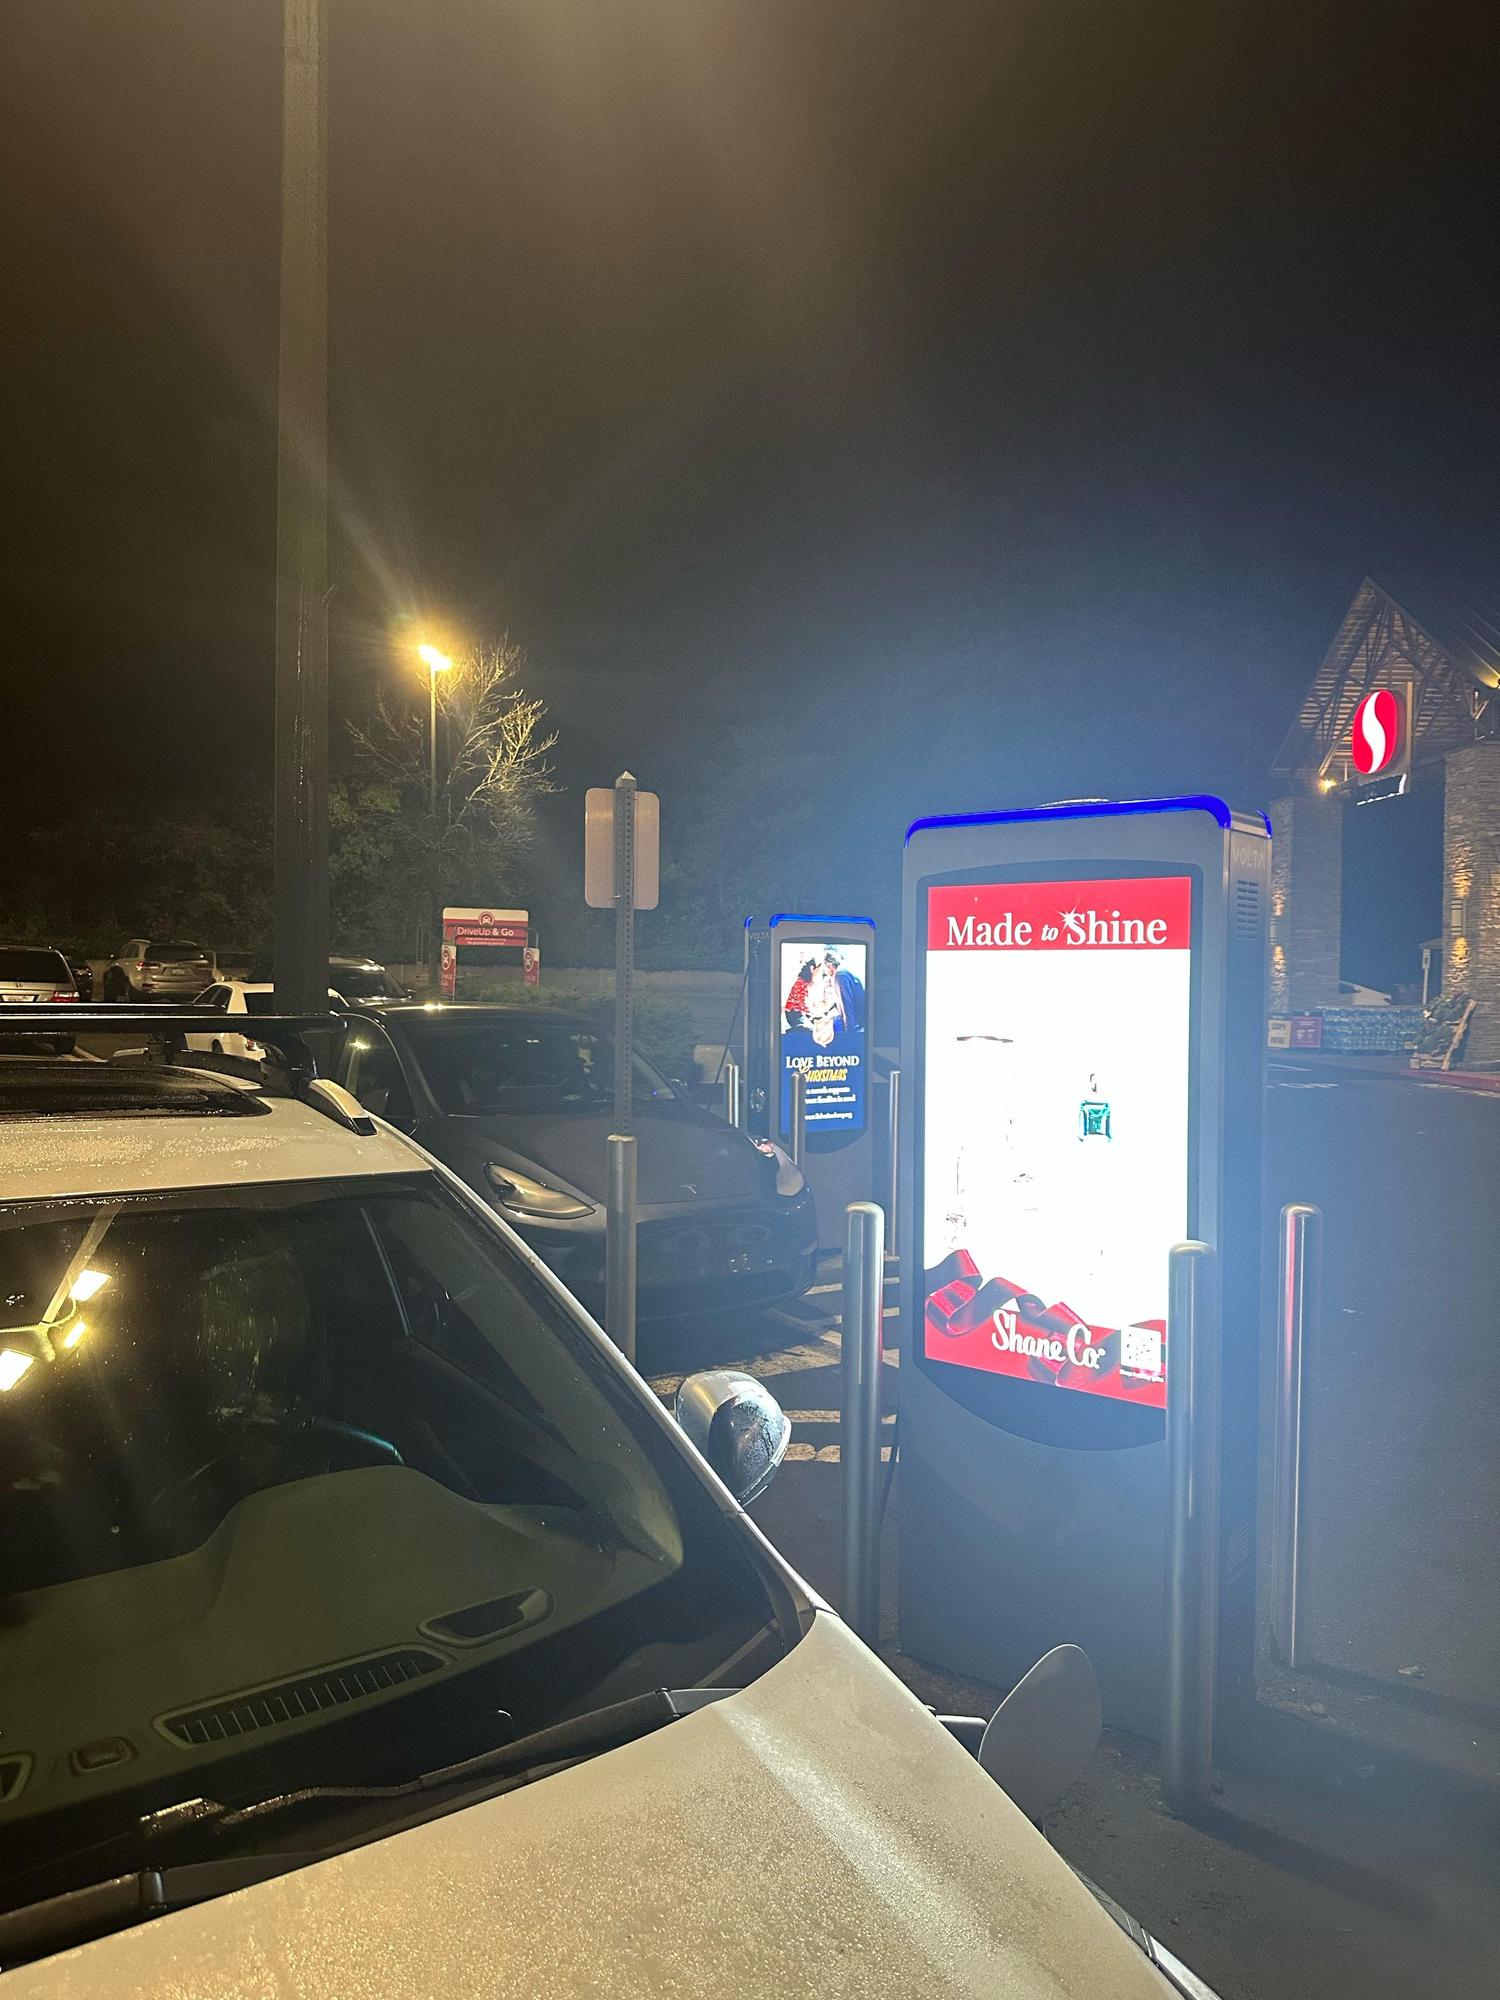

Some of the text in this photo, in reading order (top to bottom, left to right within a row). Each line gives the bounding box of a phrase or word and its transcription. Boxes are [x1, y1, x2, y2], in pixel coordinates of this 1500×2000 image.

[1232, 848, 1266, 870] VOLTA
[457, 927, 514, 937] DriveUp & Go
[946, 910, 1167, 946] Made to Shine
[785, 1055, 860, 1068] LOVE BEYOND
[991, 1309, 1066, 1362] Shane
